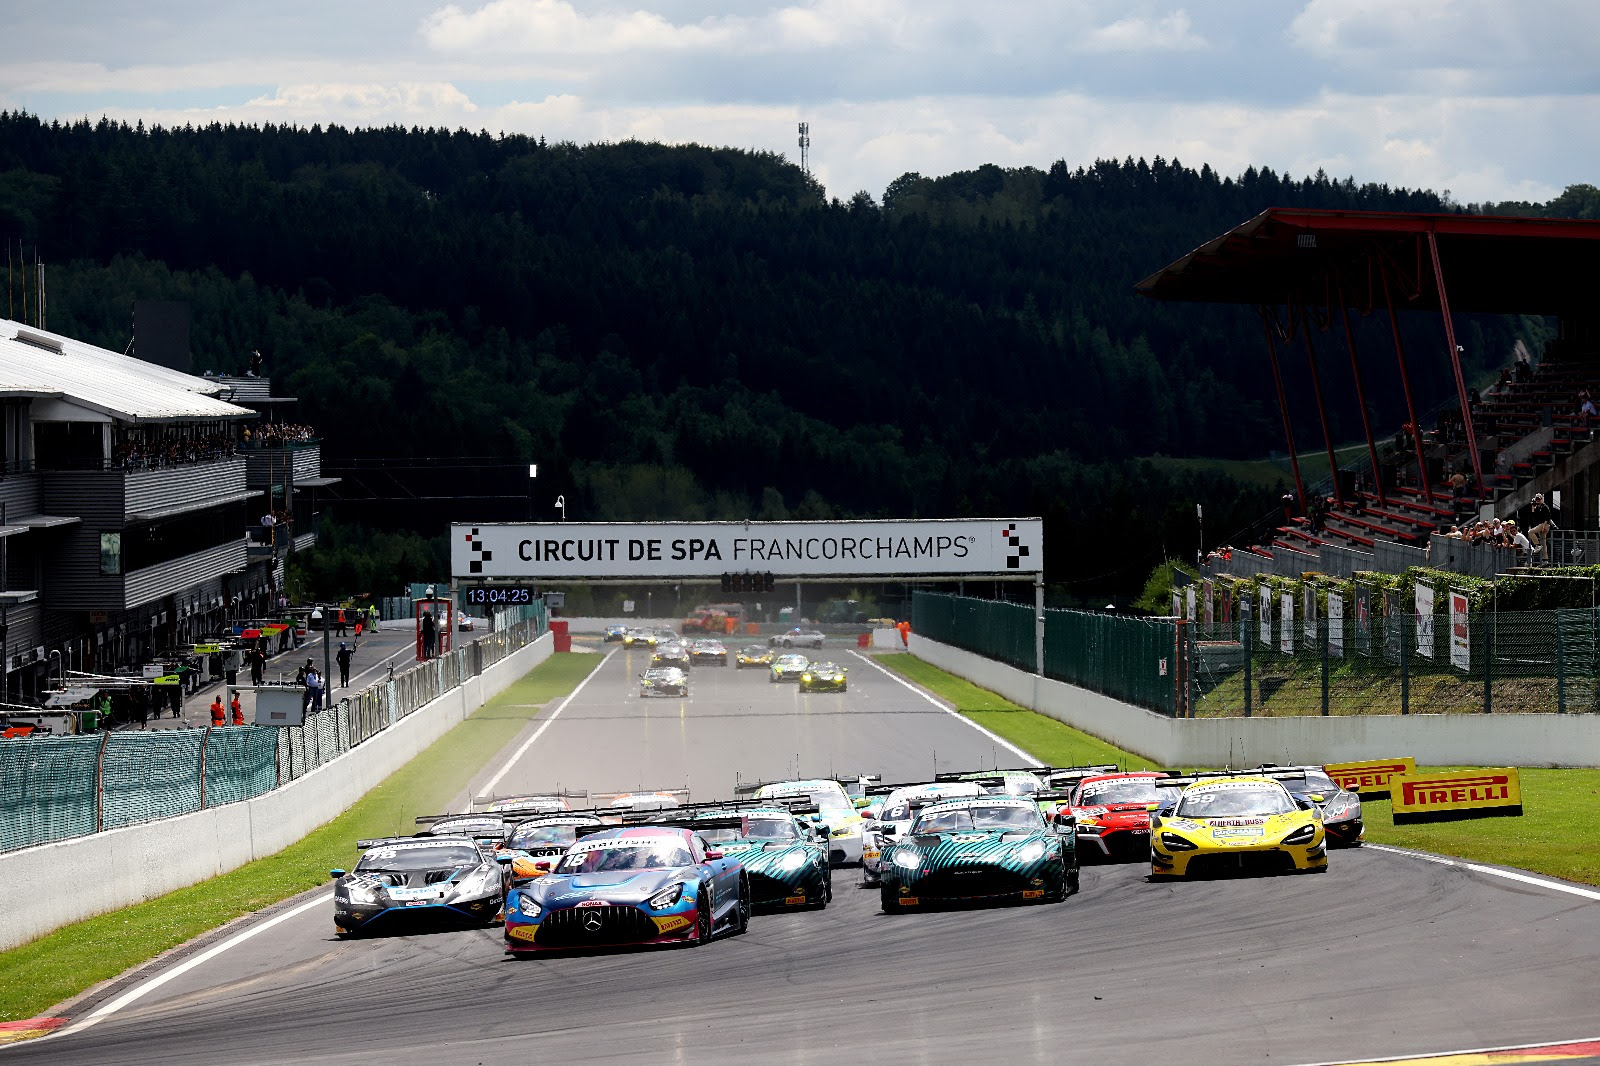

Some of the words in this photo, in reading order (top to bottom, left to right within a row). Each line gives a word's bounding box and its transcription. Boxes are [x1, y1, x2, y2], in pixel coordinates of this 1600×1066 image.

[518, 539, 620, 562] CIRCUIT
[628, 539, 662, 561] DE
[671, 539, 722, 561] SPA
[468, 588, 530, 603] 13:04:25
[1402, 775, 1509, 806] PIRELLI
[1186, 793, 1217, 805] 59
[563, 853, 589, 868] 18
